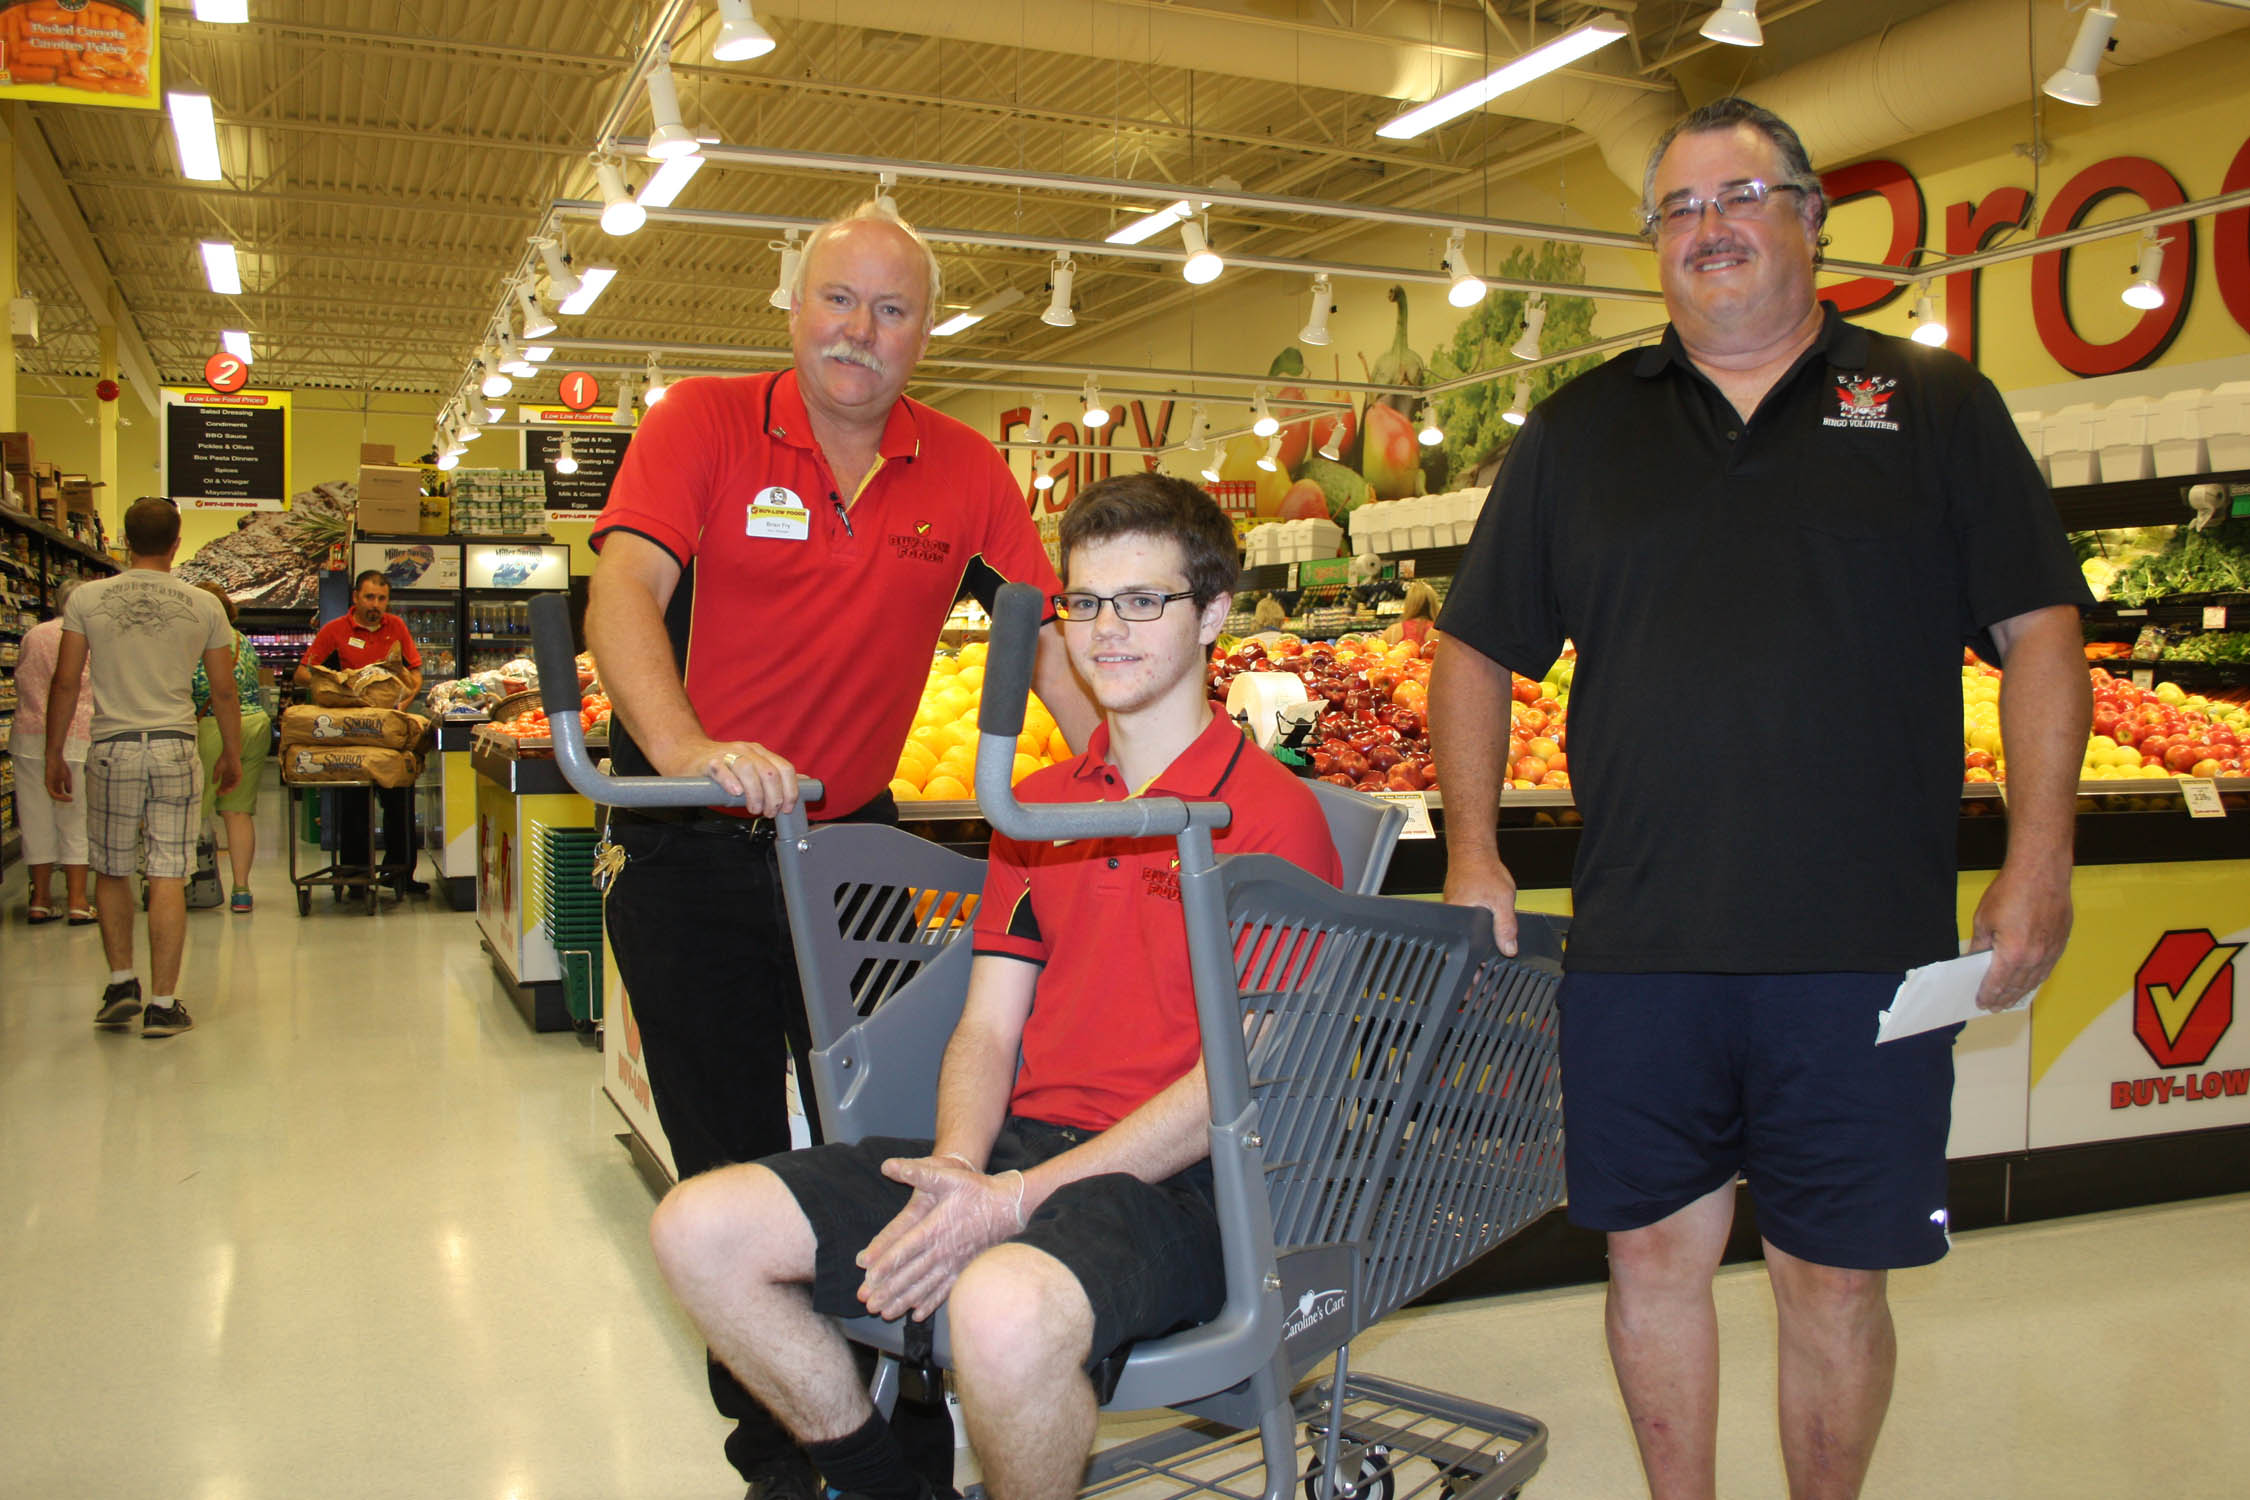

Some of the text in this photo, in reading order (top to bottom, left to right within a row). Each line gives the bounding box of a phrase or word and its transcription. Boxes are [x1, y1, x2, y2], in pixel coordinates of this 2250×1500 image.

[77, 27, 126, 39] Carrots
[1815, 132, 2250, 379] Pro
[213, 360, 239, 385] 2
[1837, 375, 1896, 387] ELKS
[573, 377, 584, 404] 1
[222, 409, 254, 417] Dressing
[1823, 417, 1898, 431] BINGO VOLUNTEER
[222, 478, 249, 486] Vinegar
[2110, 1067, 2250, 1110] BUY-LOW
[1282, 1296, 1345, 1341] Caroline's Cart
